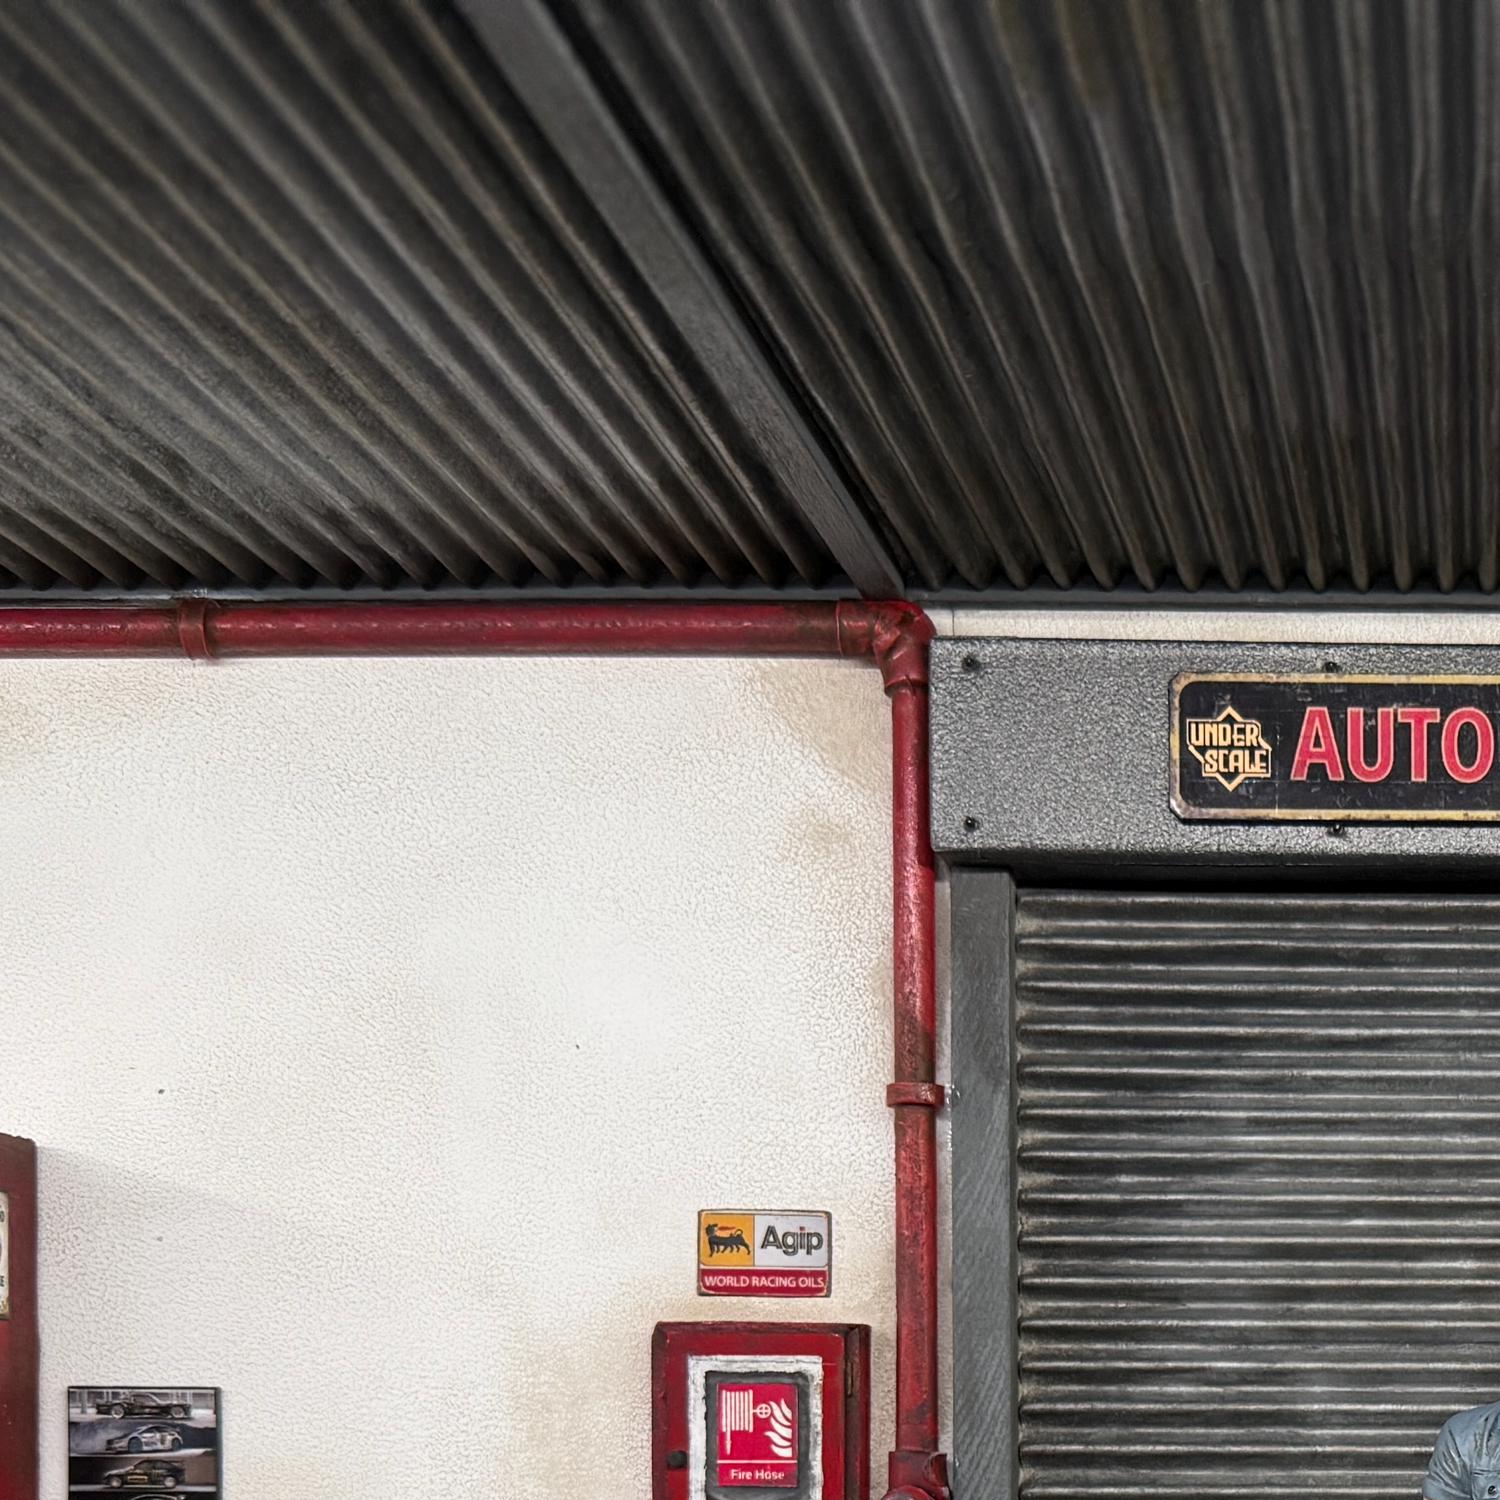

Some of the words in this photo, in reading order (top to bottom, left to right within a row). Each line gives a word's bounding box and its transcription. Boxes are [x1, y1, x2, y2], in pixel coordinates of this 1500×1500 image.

[1190, 722, 1260, 748] UNDER
[1290, 706, 1495, 783] AUTO
[1204, 749, 1268, 774] SCALE
[760, 1225, 823, 1256] Agip
[704, 1275, 749, 1288] WORLD
[752, 1275, 797, 1288] RACING
[798, 1276, 825, 1288] OILS
[730, 1468, 753, 1480] Fire
[755, 1468, 785, 1480] Hose
